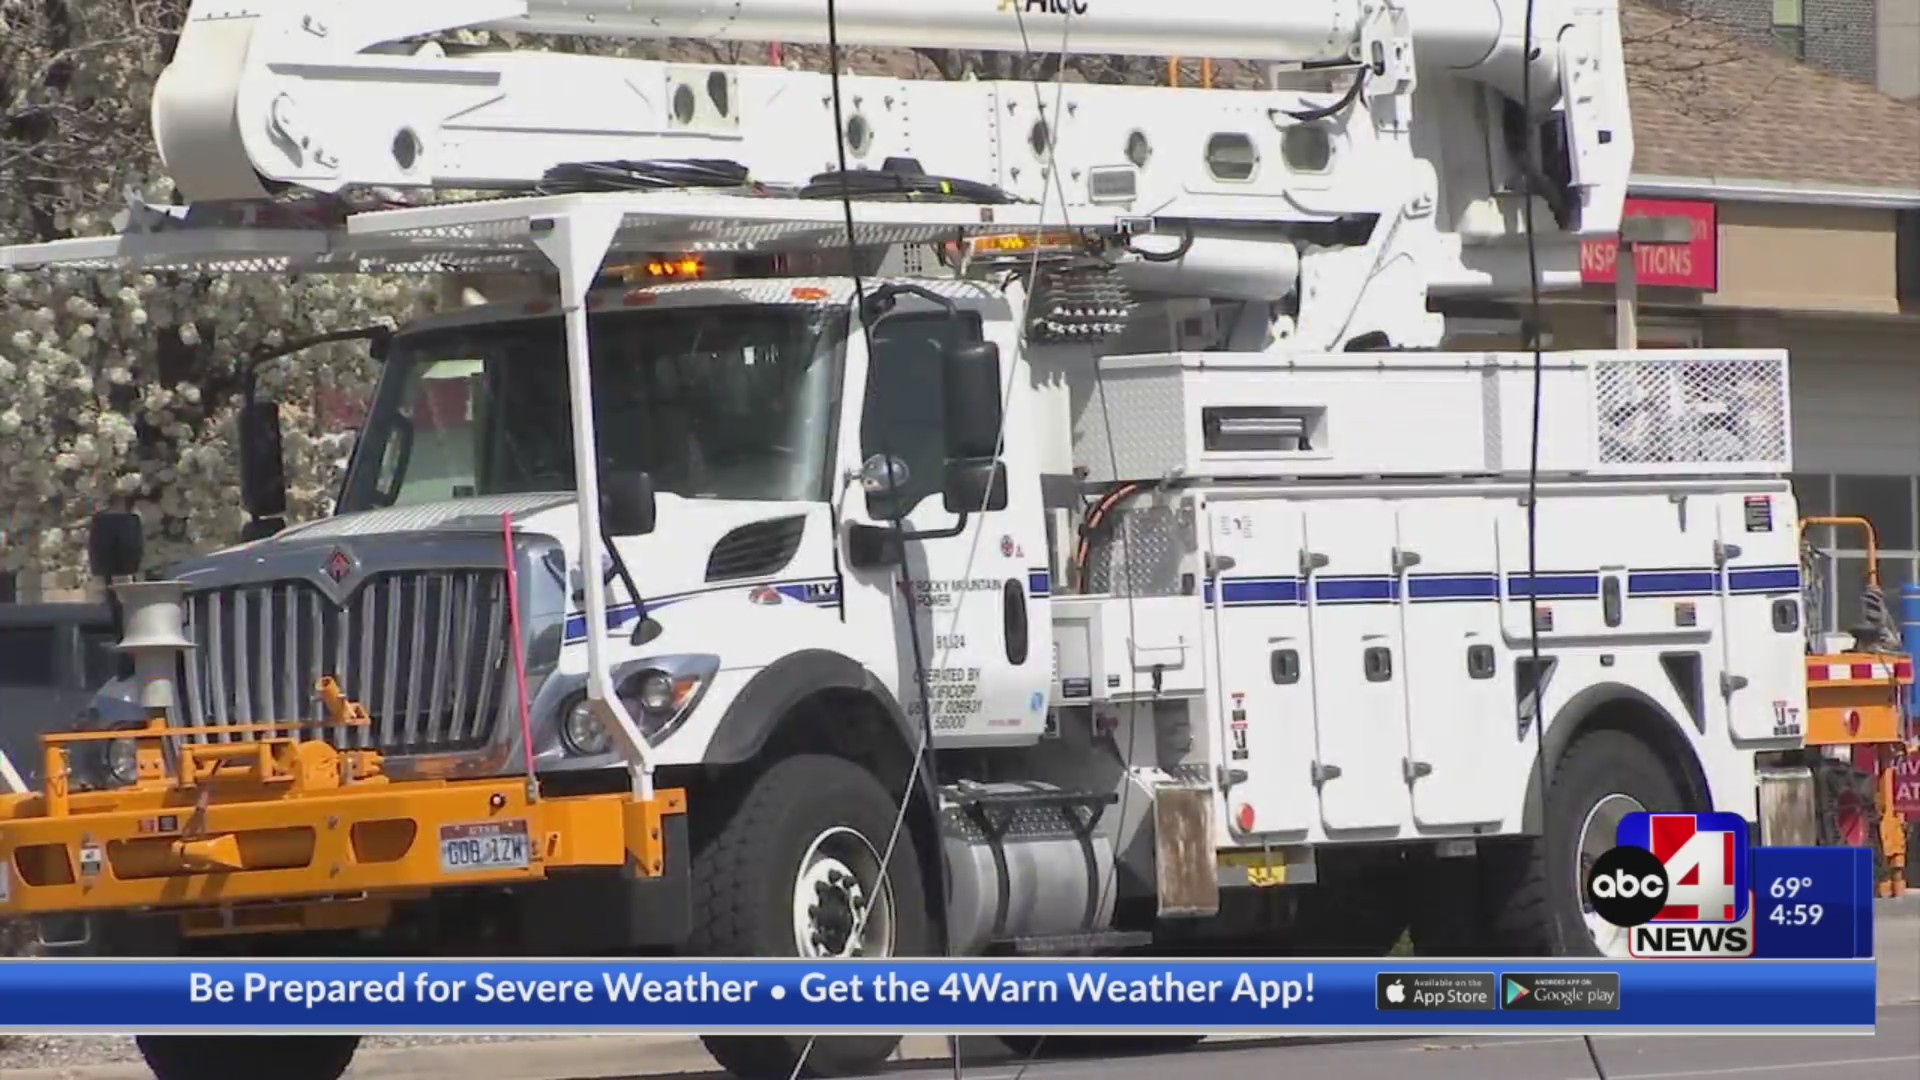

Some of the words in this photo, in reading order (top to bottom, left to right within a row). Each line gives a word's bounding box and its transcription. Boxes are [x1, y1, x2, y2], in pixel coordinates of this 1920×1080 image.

[1579, 241, 1693, 276] NSPTIONS
[912, 668, 965, 682] OERATED
[920, 685, 976, 698] ACIFICORP
